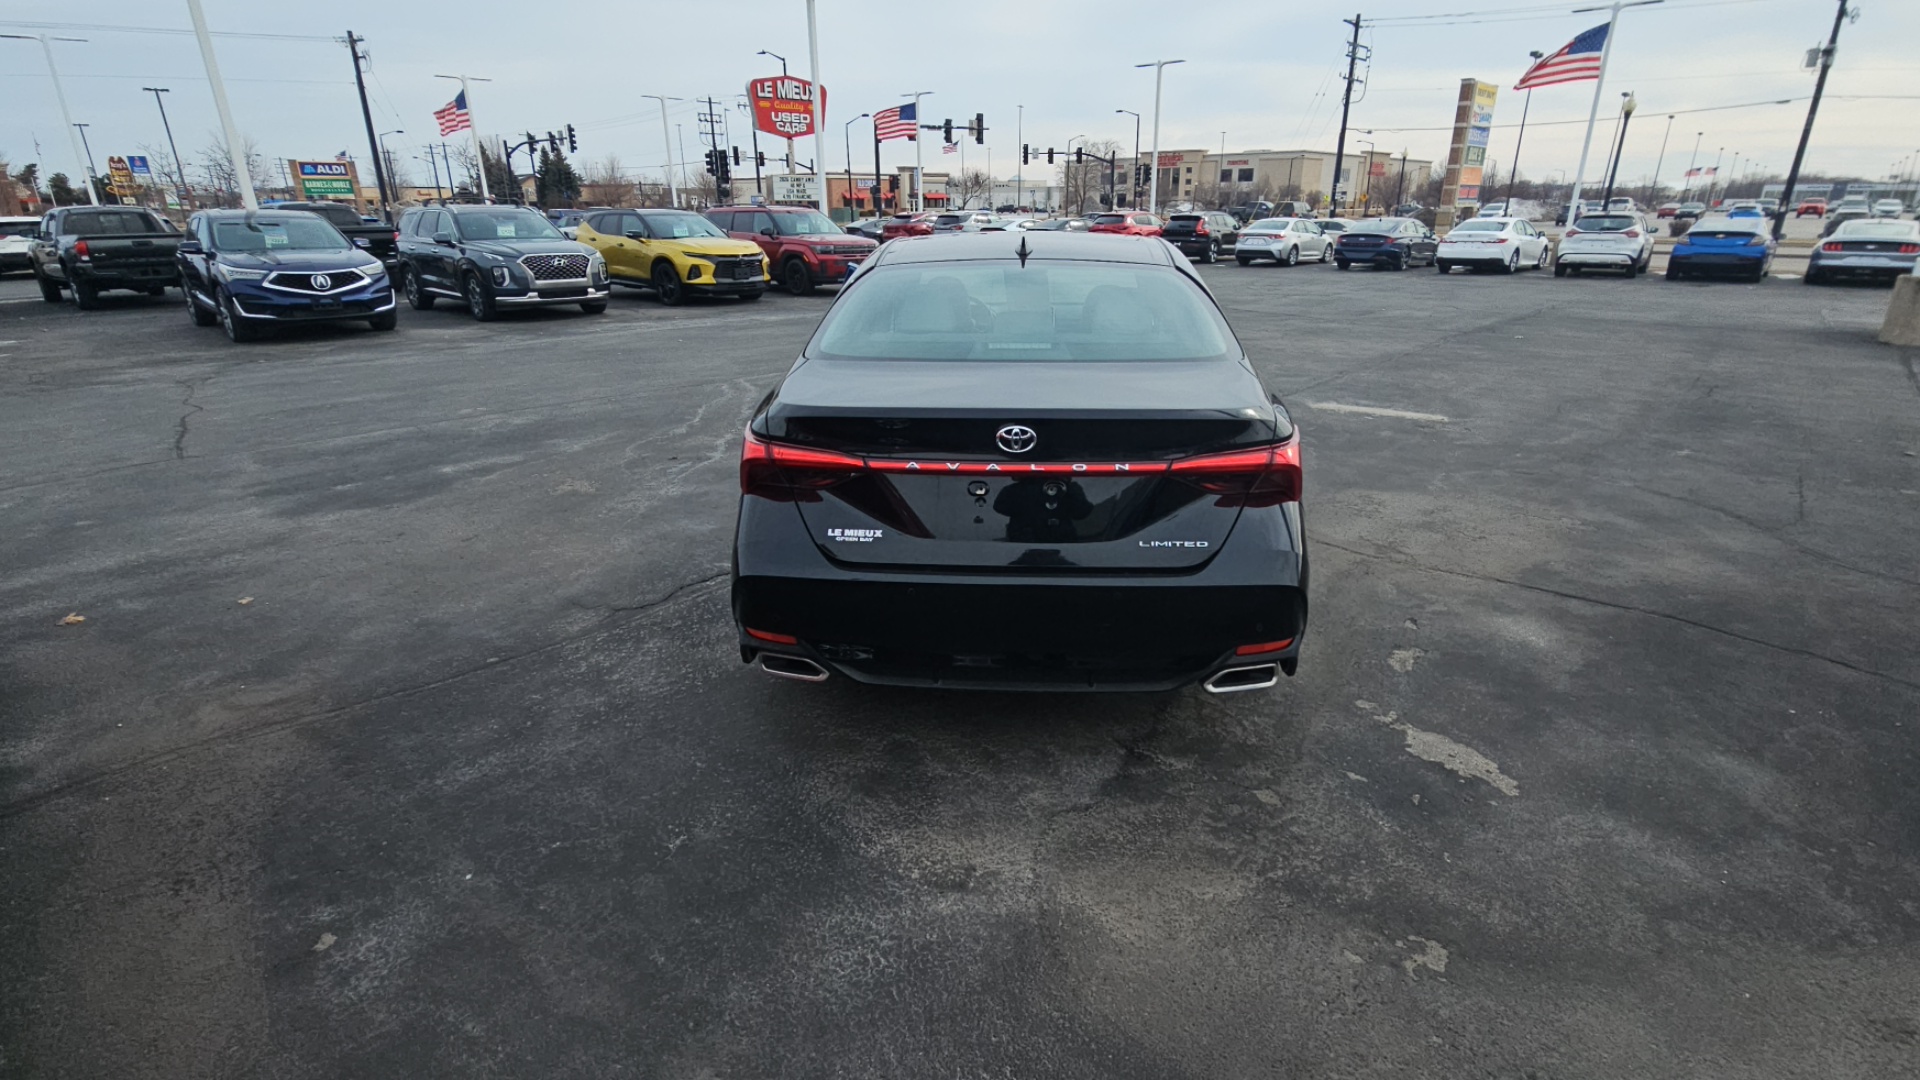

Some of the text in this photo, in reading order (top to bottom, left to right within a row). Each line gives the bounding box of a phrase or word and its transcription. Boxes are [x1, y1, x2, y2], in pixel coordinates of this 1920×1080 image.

[757, 81, 773, 98] LE
[774, 100, 804, 112] Quality
[771, 111, 811, 123] USED
[776, 122, 807, 134] CARS
[317, 164, 346, 174] ALDI
[906, 461, 1129, 471] AVALON
[844, 529, 883, 537] MIEUX
